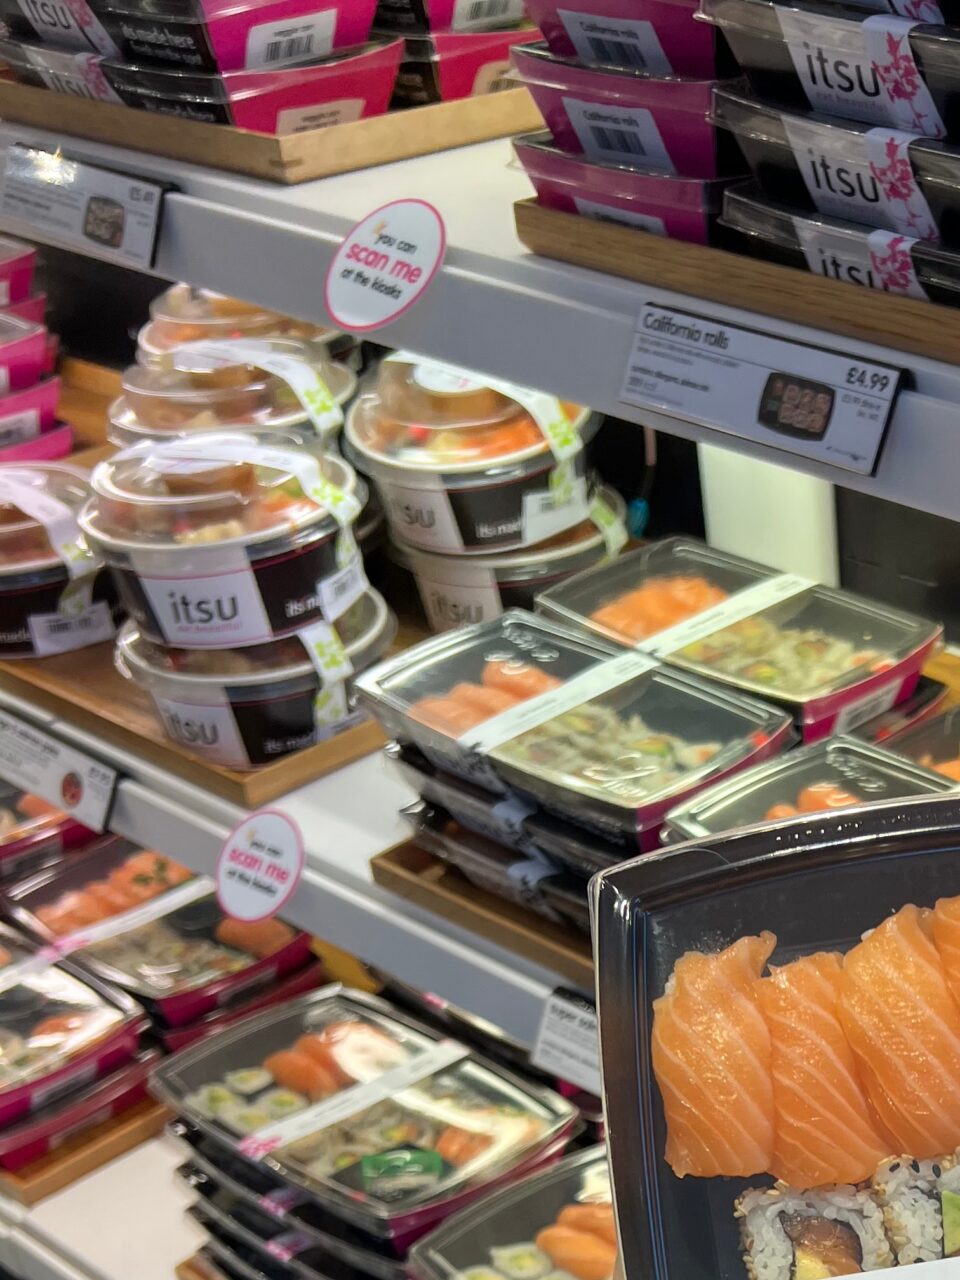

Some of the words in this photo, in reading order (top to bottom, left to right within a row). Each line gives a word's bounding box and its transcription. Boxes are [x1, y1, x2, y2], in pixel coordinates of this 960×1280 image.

[803, 41, 881, 98] itsu
[808, 147, 880, 203] itsu
[345, 243, 390, 272] scan
[389, 260, 423, 285] me
[643, 313, 702, 343] California
[703, 330, 729, 350] rolls
[846, 367, 890, 392] £4.99
[167, 592, 239, 624] itsu
[229, 848, 262, 870] scan
[265, 863, 289, 884] me
